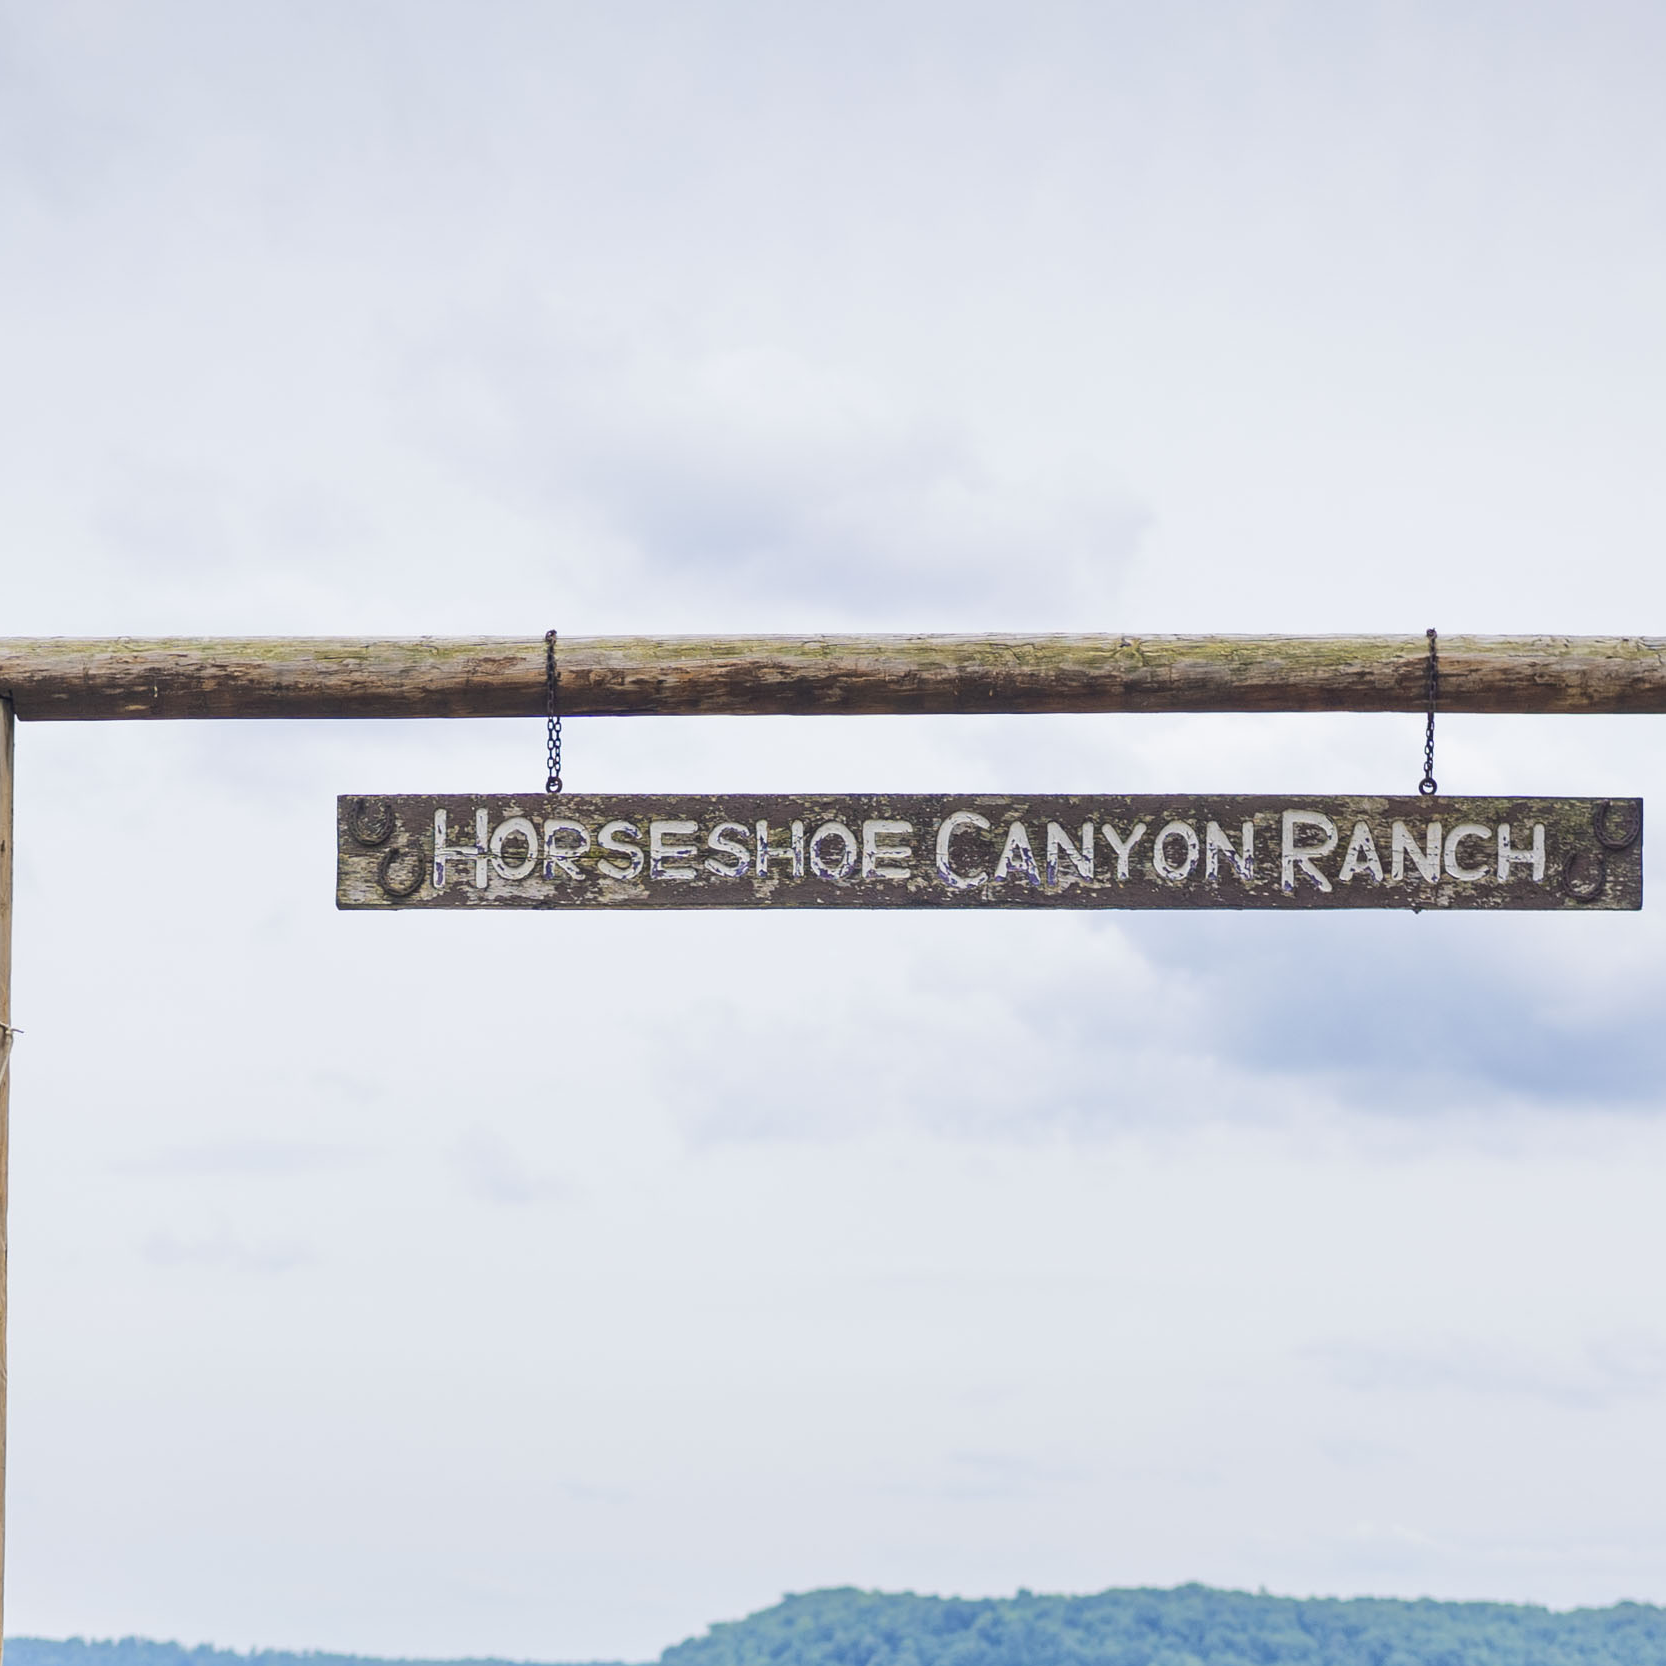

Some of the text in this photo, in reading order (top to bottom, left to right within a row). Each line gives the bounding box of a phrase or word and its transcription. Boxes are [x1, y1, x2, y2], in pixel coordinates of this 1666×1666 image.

[433, 807, 1546, 892] HORSESHOE CANYON RANCH
